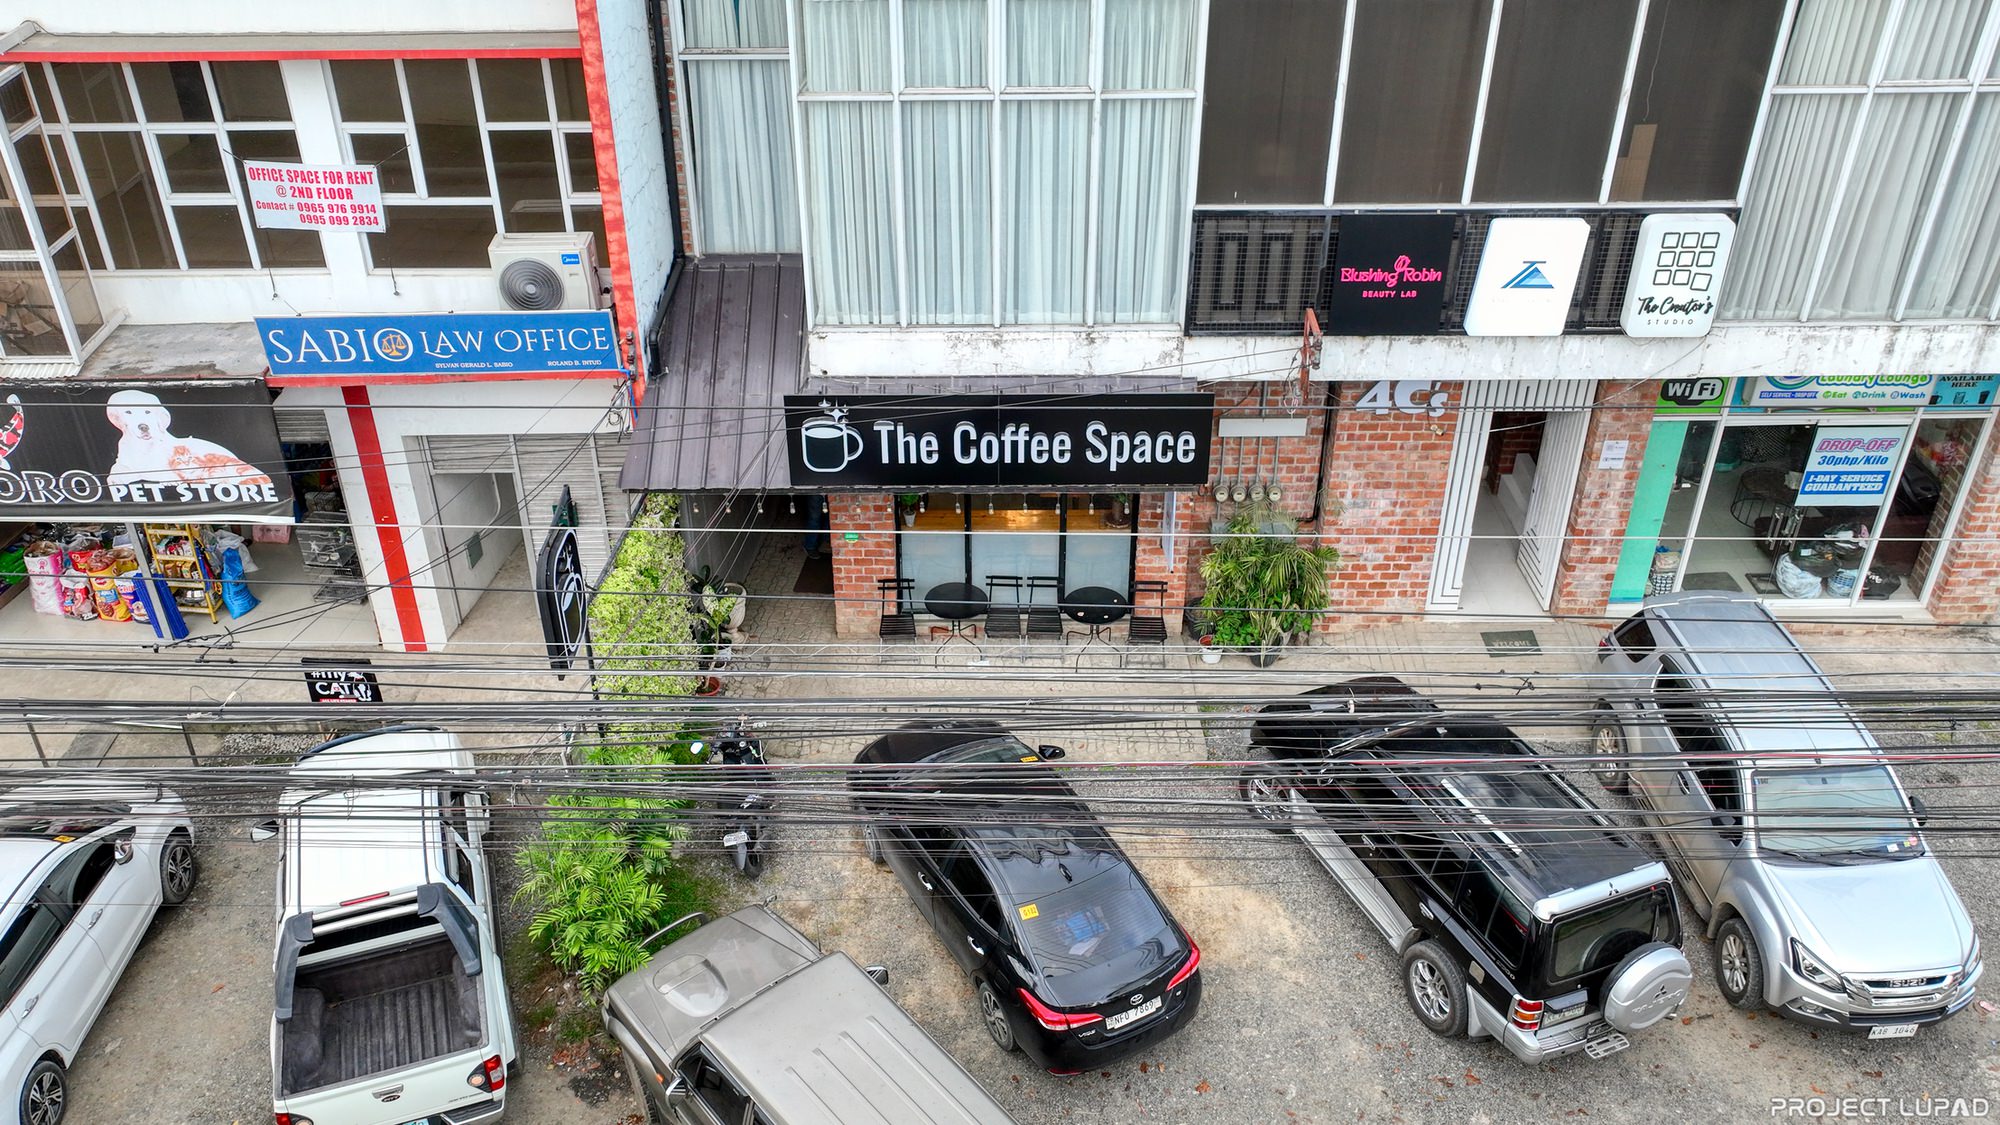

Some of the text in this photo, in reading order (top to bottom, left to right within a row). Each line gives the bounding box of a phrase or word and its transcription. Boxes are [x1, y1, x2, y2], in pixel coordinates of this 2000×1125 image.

[248, 167, 374, 185] OFFICE SPACE FOR RENT
[276, 185, 354, 200] @ 2ND FLOOR
[256, 200, 287, 211] Contact
[297, 202, 325, 213] 0965
[328, 203, 348, 214] 976
[350, 204, 377, 214] 9914
[299, 213, 379, 226] 0995 099 2834
[1340, 266, 1442, 287] Blushing Robin
[1362, 290, 1417, 298] BEAUTY LAB
[1637, 296, 1714, 315] The Creator's
[268, 327, 610, 364] SABIO LAW OFFICE
[1832, 391, 1926, 399] Eat Drink Wash
[873, 419, 1196, 472] The Coffee Space
[1816, 438, 1900, 452] DROP-OFF
[1817, 455, 1889, 466] 30php/Kilo
[1839, 474, 1885, 483] SERVICE
[110, 483, 161, 503] PET
[178, 482, 279, 503] STORE
[1804, 483, 1884, 492] GUARANTEED
[315, 682, 351, 695] CAT
[1890, 978, 1927, 988] ISUZU
